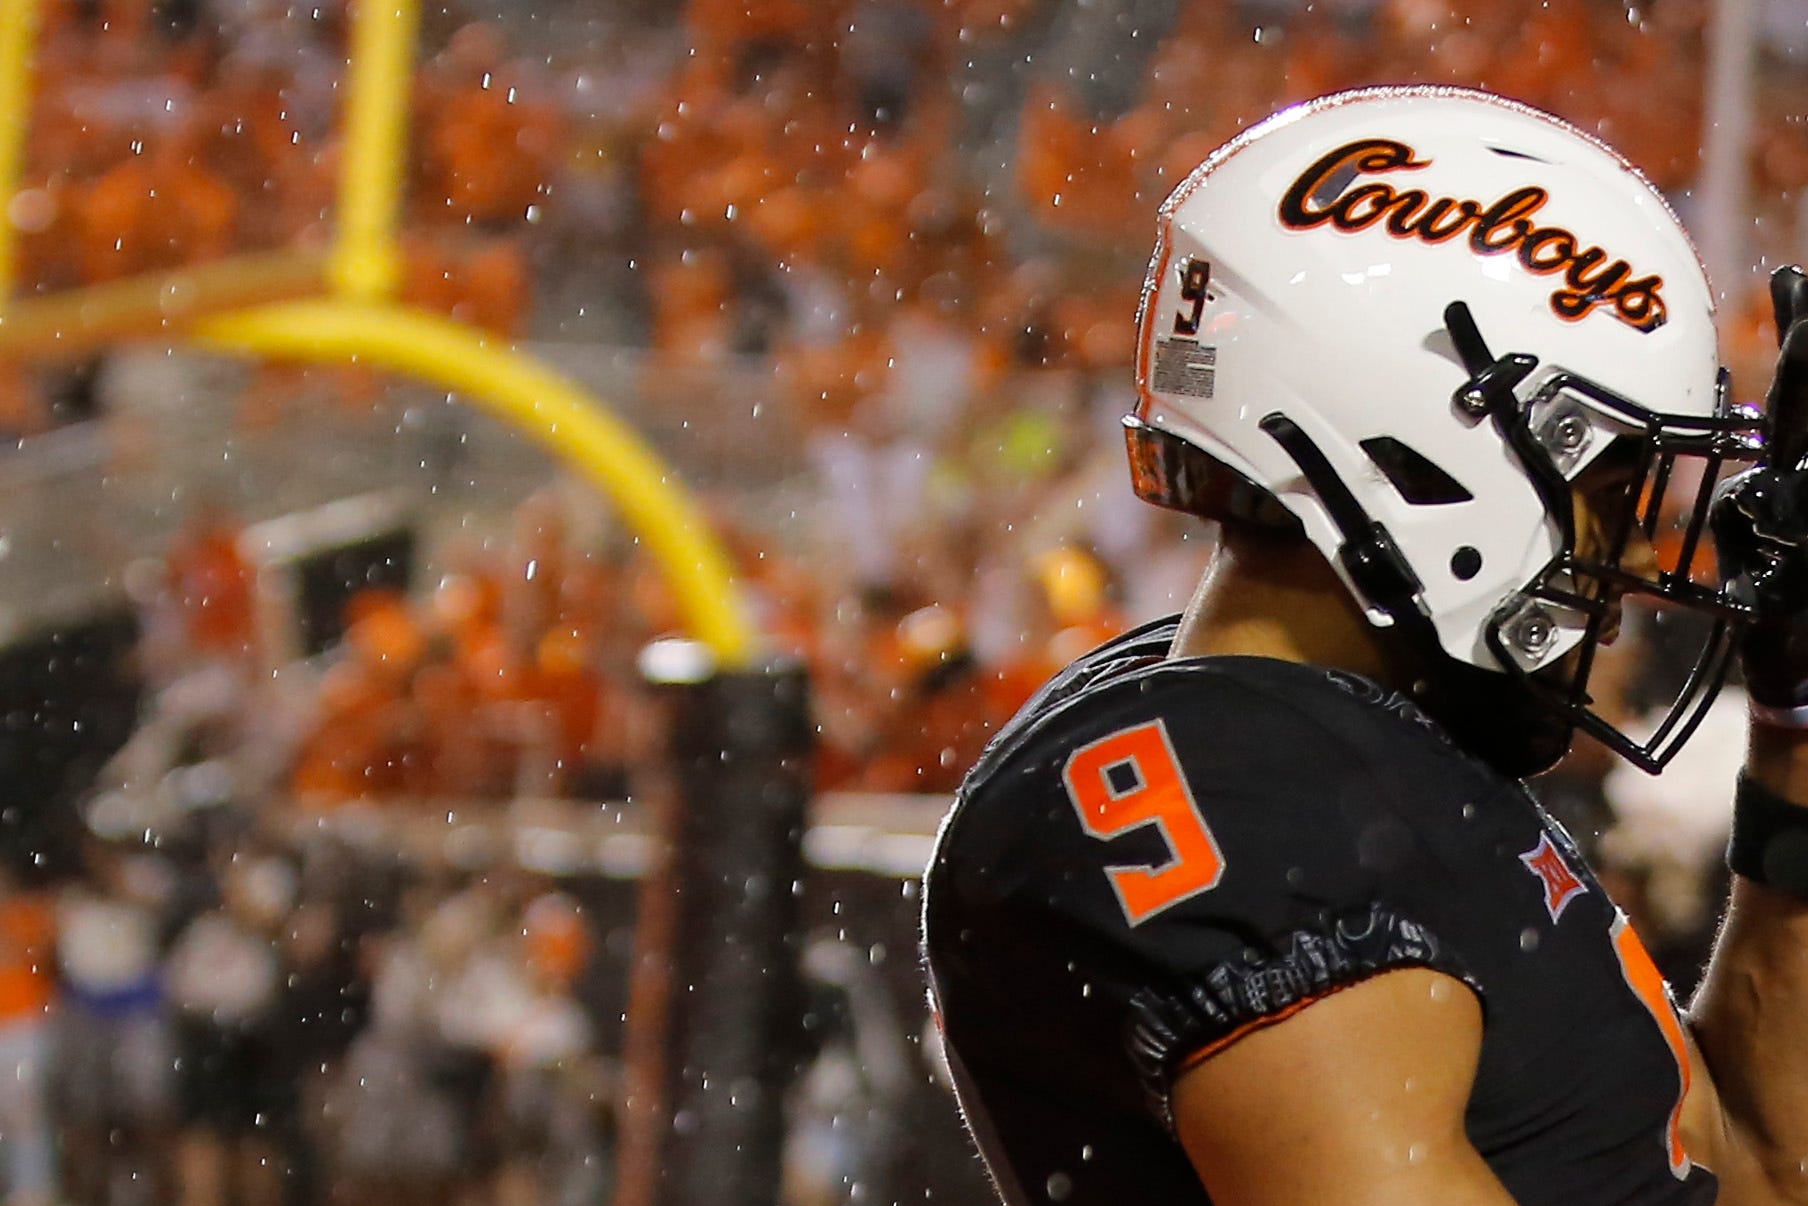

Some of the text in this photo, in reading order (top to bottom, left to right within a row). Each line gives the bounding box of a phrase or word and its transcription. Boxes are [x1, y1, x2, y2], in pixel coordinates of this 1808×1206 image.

[1173, 258, 1211, 335] 9
[1278, 137, 1667, 325] Cowboys
[1061, 717, 1225, 928] 9
